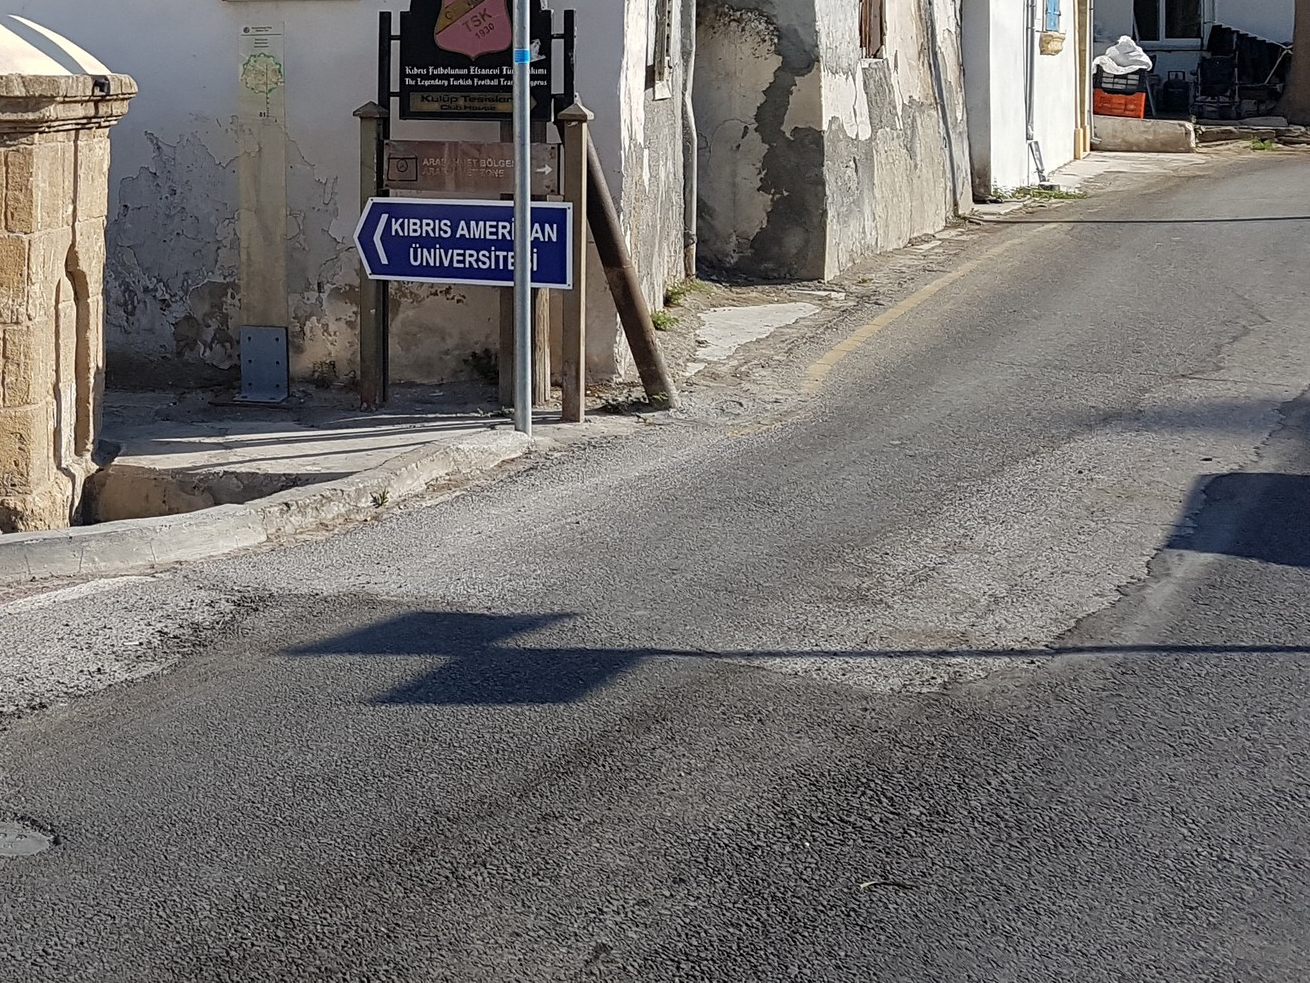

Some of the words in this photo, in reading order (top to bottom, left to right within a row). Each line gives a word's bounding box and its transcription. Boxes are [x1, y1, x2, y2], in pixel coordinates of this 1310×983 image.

[462, 7, 493, 32] TSK
[475, 22, 495, 39] 1930
[417, 78, 448, 87] Legendary
[450, 78, 472, 86] Turkish
[474, 78, 499, 86] Football
[500, 78, 514, 86] Tea
[463, 95, 513, 103] Tesisler
[479, 157, 515, 167] BÖLGE
[391, 218, 452, 238] KIBRIS
[455, 218, 558, 242] AMERİAN
[409, 243, 538, 271] ÜNİVERSİTEİ
